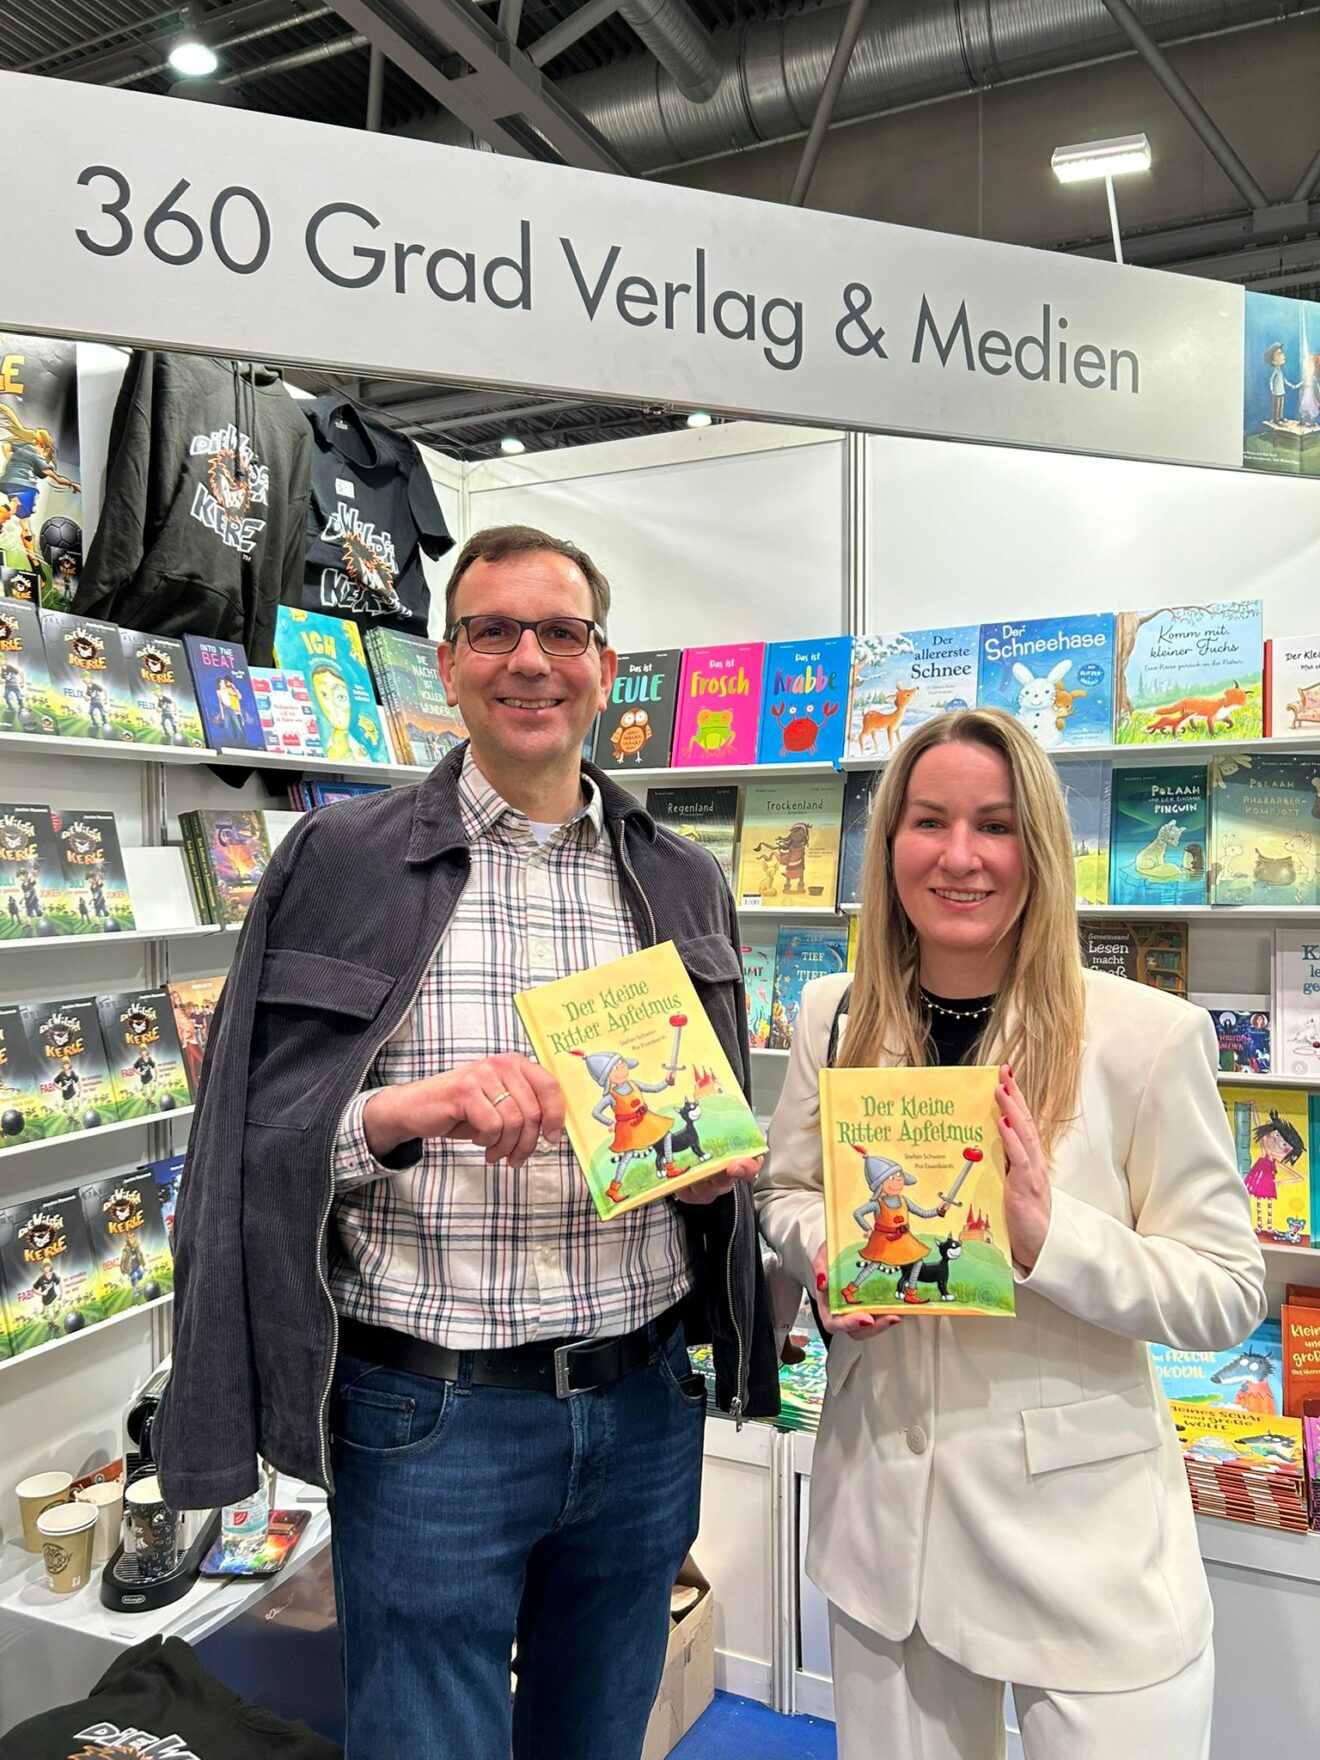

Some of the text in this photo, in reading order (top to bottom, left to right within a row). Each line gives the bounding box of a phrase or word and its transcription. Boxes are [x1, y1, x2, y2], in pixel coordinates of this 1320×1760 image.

[75, 165, 1141, 394] 360 Grad Verlag & Medien
[932, 635, 953, 646] Der
[1002, 625, 1025, 639] Der
[1157, 624, 1201, 644] Komm
[200, 644, 234, 657] INTO THE
[301, 631, 337, 659] ICH
[985, 630, 1106, 661] Schneehase
[1150, 637, 1240, 658] kleiner Fuchs
[68, 653, 107, 670] KERLE
[201, 652, 235, 669] BEAT
[795, 652, 820, 662] Das ist
[914, 647, 970, 661] allererste
[1285, 652, 1302, 661] Der
[412, 665, 437, 679] NACHT
[630, 663, 652, 673] Das ist
[709, 658, 735, 669] Das ist
[911, 663, 972, 679] Schnee
[141, 668, 175, 684] KERLE
[691, 667, 750, 697] Frosch
[774, 664, 838, 695] Krabbe
[612, 674, 665, 704] EULE
[667, 801, 714, 816] Regenland
[767, 800, 824, 811] Trockenland
[1155, 803, 1198, 814] PINGUIN
[67, 848, 105, 865] KERLE
[1088, 941, 1129, 954] Lesen
[801, 952, 825, 962] TIEF
[1093, 956, 1125, 965] macht
[562, 981, 649, 1022] Der kleine
[547, 994, 682, 1055] Ritter Apfelmus
[125, 1026, 160, 1044] KERLE
[45, 1038, 85, 1058] KERLE
[861, 1095, 954, 1119] Der kleine
[836, 1120, 983, 1147] Ritter Apfelmus
[108, 1210, 144, 1234] KERLE
[24, 1235, 68, 1262] KERLE
[1165, 1350, 1217, 1363] FRECHE
